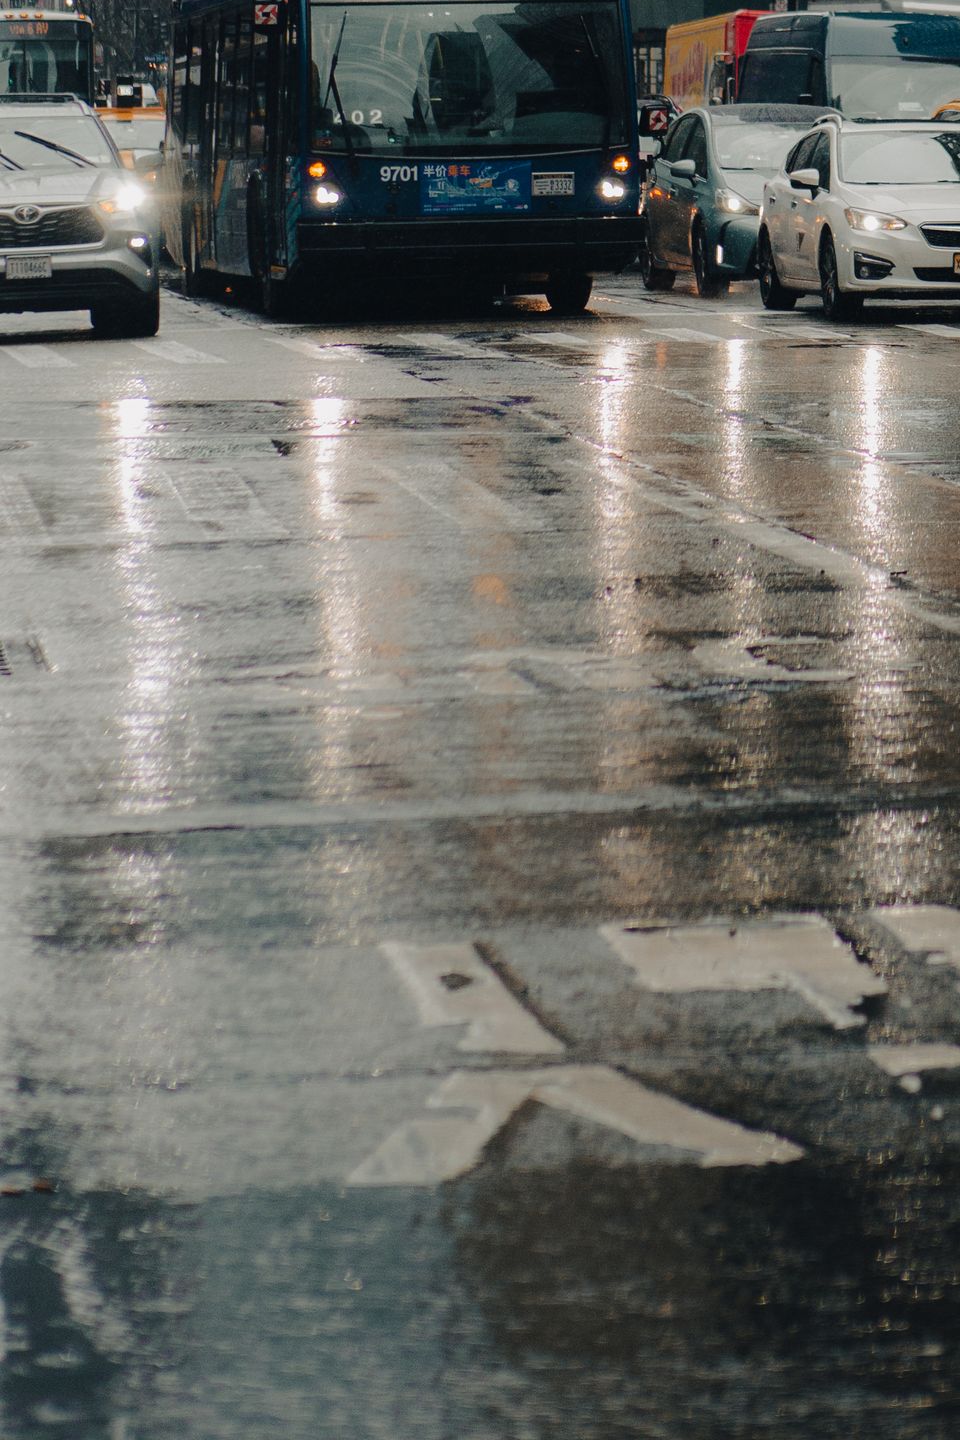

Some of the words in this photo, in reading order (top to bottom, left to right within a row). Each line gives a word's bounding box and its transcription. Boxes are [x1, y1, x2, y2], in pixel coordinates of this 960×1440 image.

[380, 165, 418, 182] 9701
[423, 164, 471, 177] 半价乘车
